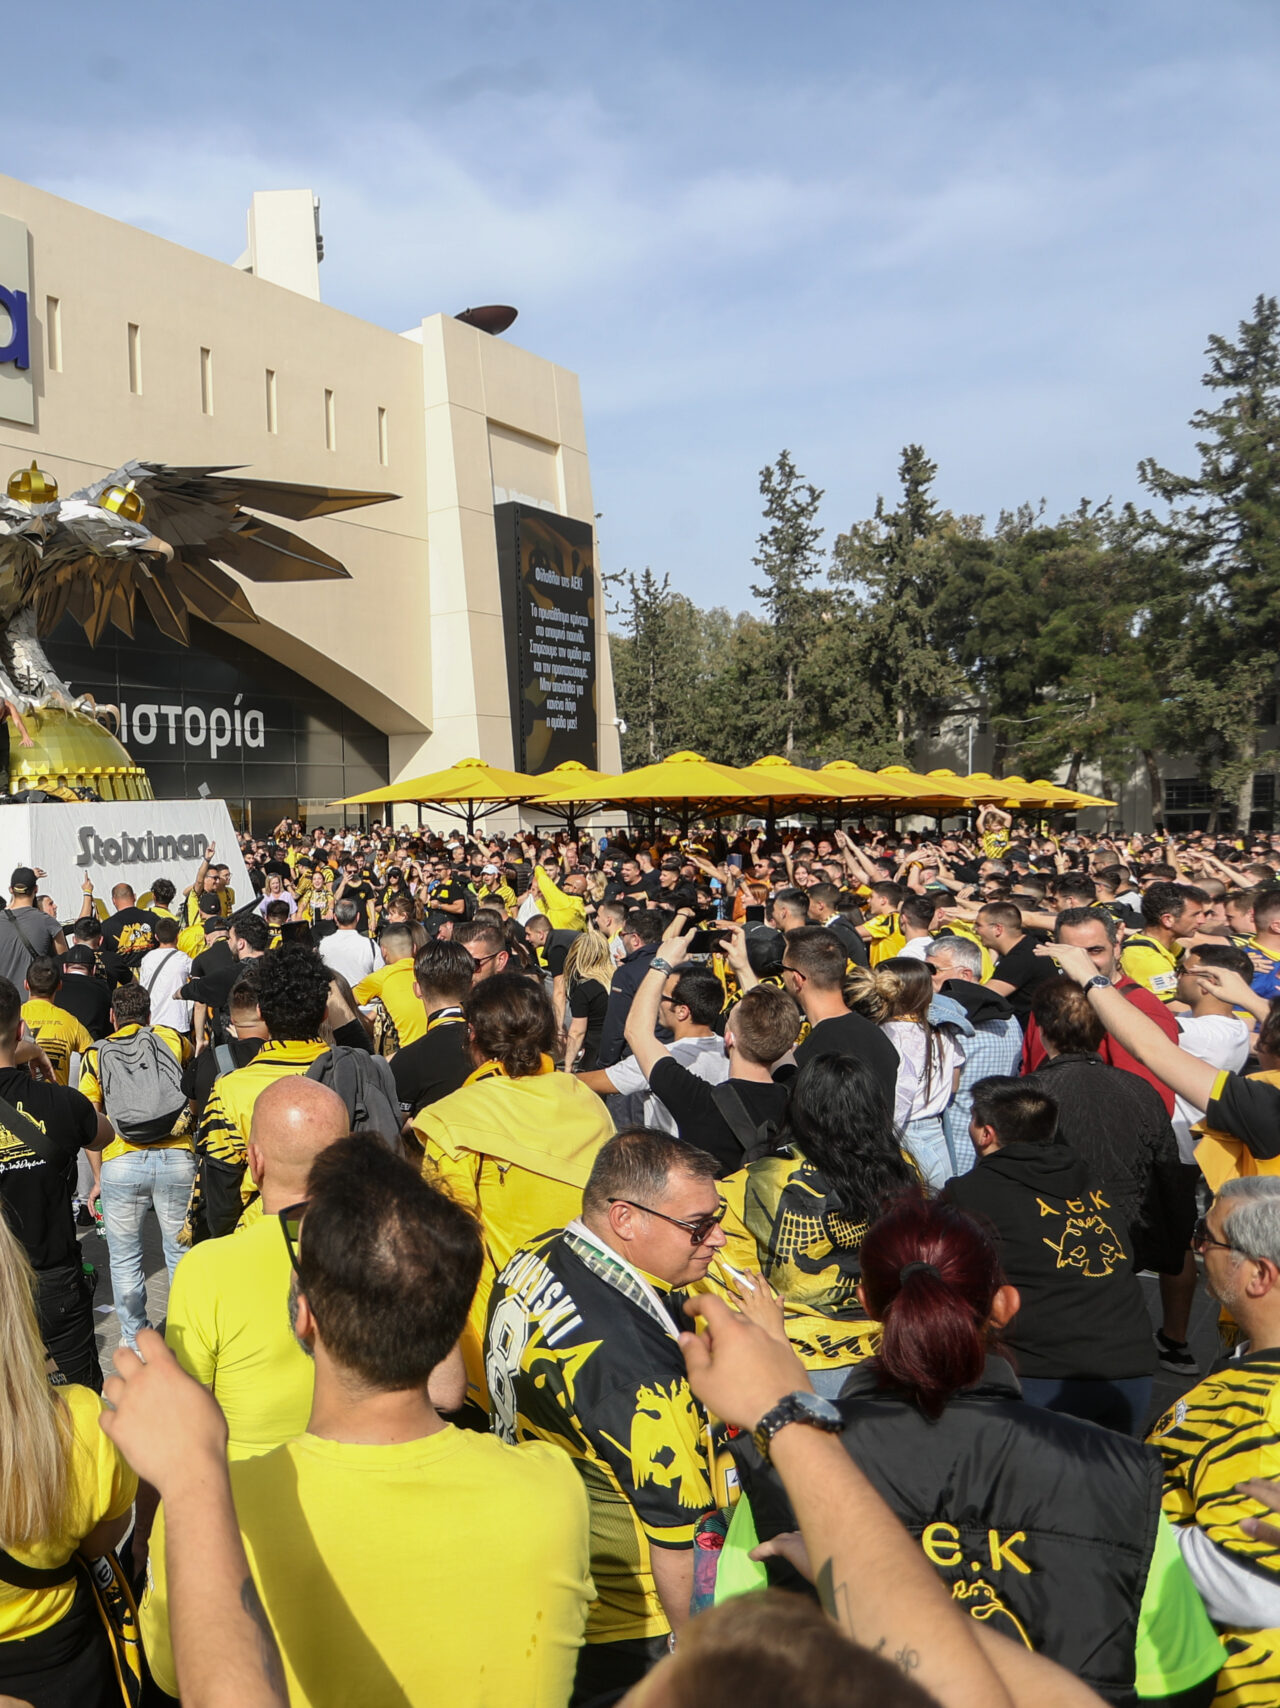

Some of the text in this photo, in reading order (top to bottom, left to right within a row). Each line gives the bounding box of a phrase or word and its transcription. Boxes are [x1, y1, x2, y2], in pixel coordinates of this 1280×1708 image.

[530, 602, 537, 617] Το
[120, 693, 265, 759] ιστορία
[76, 826, 210, 866] Stoiximan
[486, 1294, 531, 1435] 8
